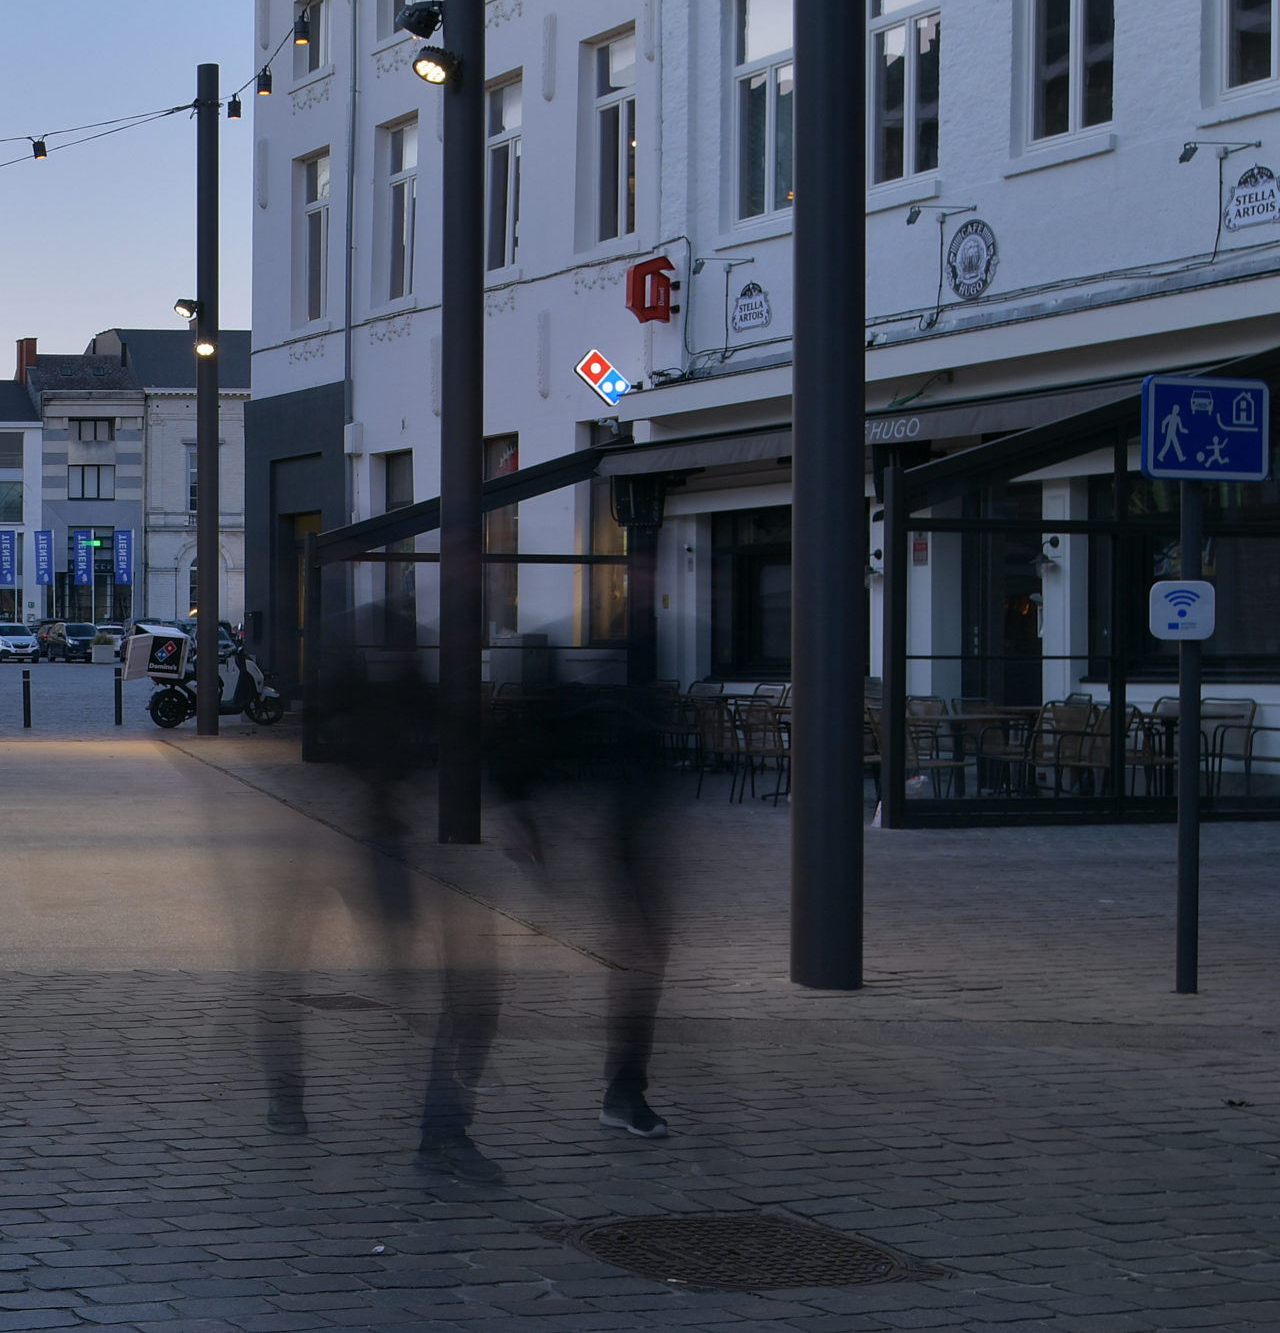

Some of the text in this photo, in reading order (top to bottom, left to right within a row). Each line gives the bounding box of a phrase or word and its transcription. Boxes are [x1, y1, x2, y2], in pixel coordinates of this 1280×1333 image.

[1235, 188, 1276, 207] STELLA
[1234, 201, 1276, 219] ARTOIS
[959, 280, 983, 296] HUGO
[738, 300, 764, 313] STELLA
[738, 311, 765, 323] ARTOIS
[869, 417, 920, 440] HUGO
